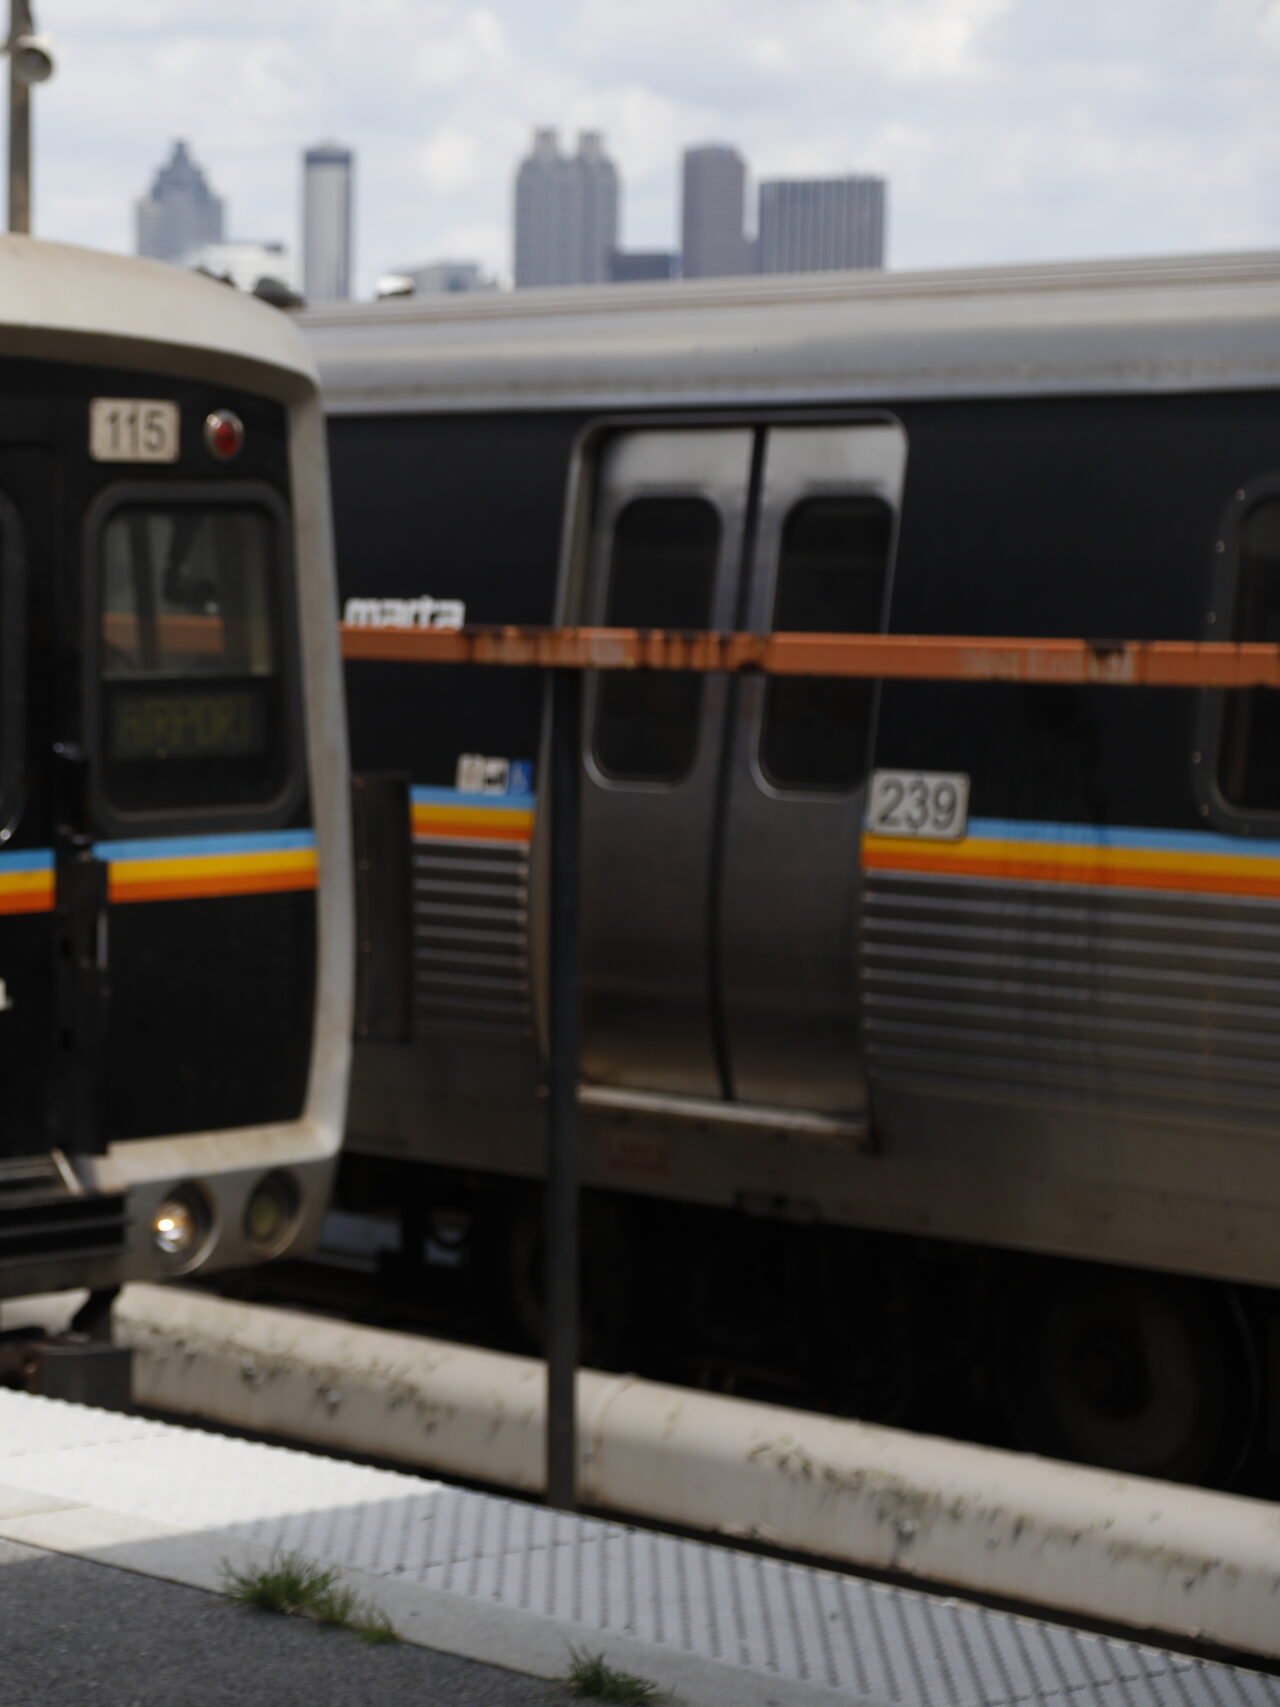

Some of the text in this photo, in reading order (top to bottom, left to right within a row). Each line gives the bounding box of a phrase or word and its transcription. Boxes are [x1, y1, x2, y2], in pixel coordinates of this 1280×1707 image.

[105, 406, 168, 455] 115
[344, 595, 467, 630] marta
[879, 778, 958, 831] 239
